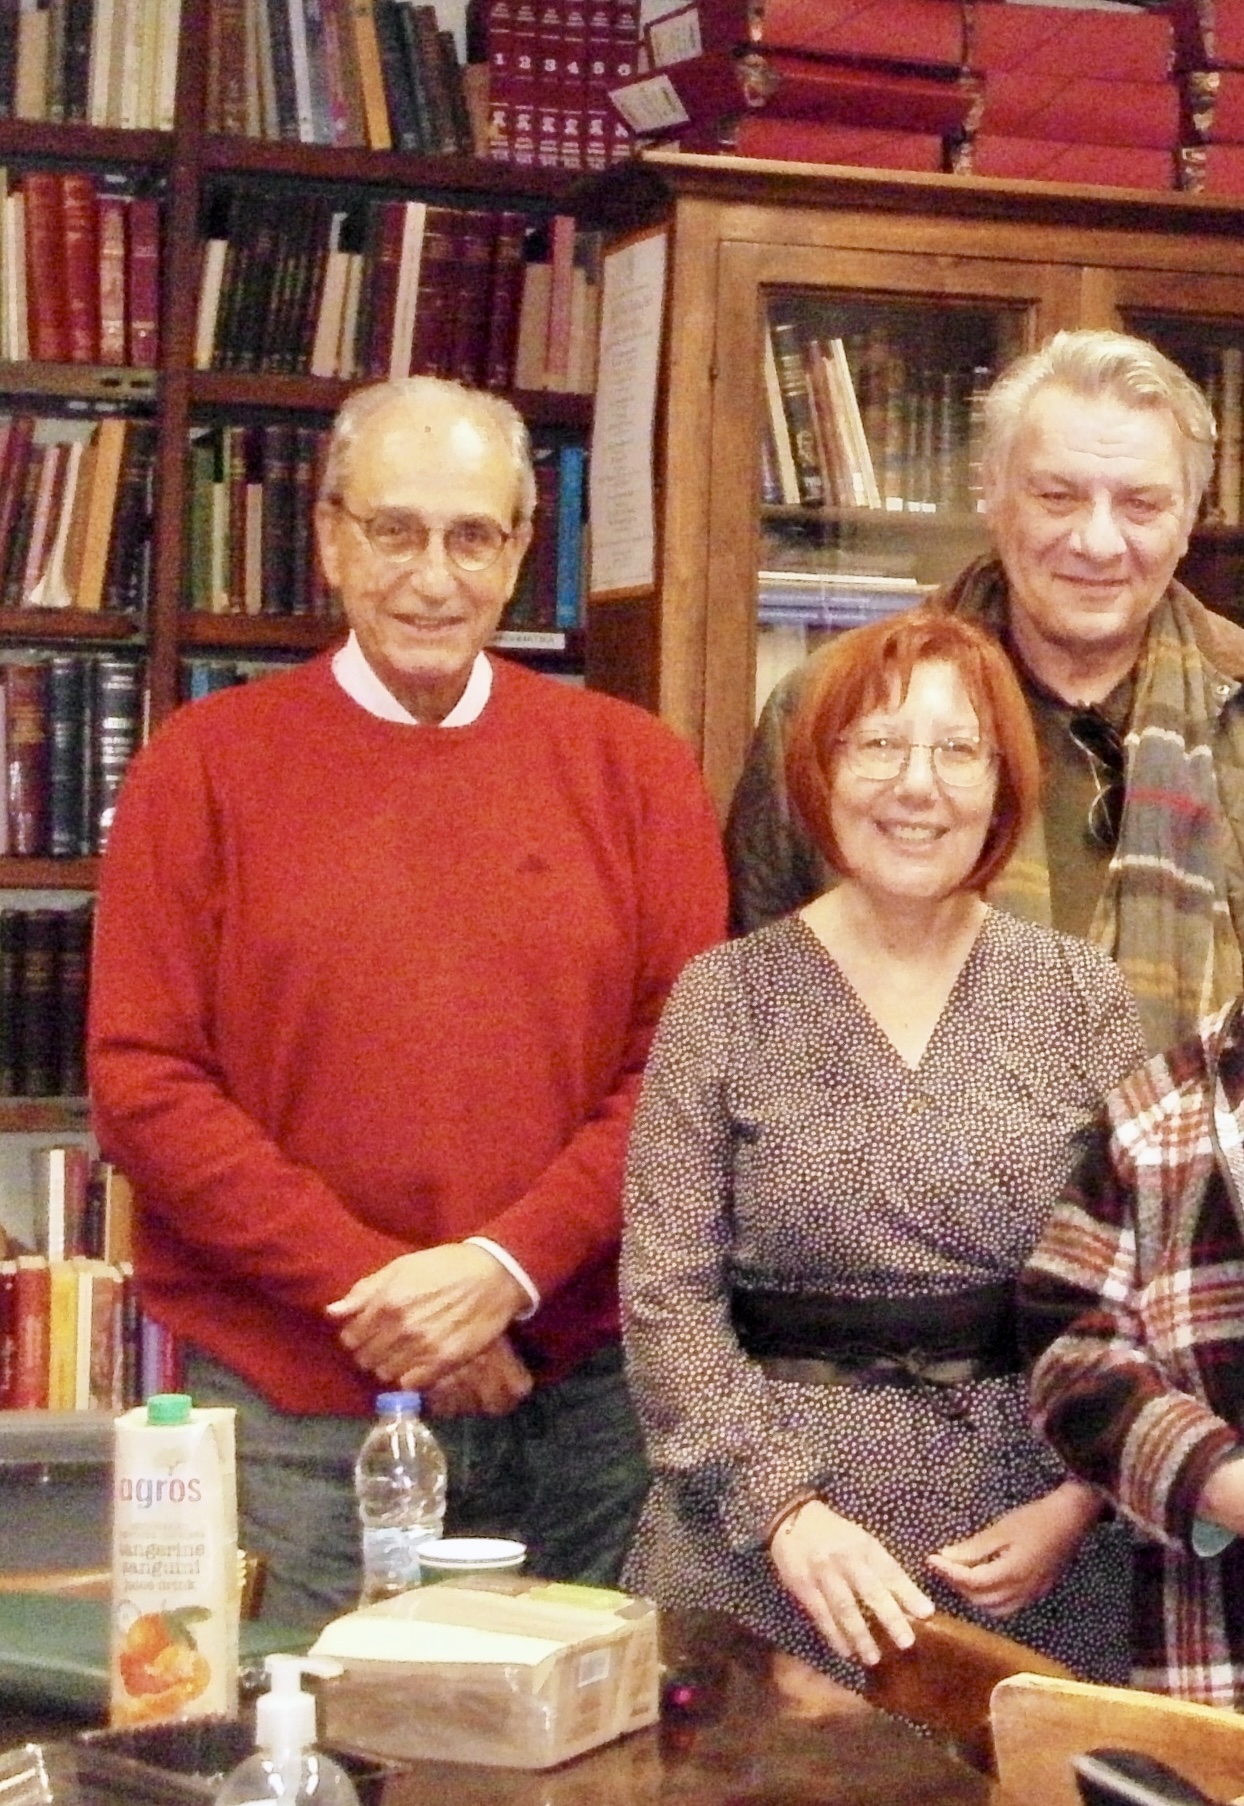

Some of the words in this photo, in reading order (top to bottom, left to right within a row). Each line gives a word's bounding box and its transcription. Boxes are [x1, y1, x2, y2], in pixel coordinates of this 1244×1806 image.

[495, 53, 504, 65] 1
[567, 61, 579, 74] 4
[120, 1477, 202, 1509] agros
